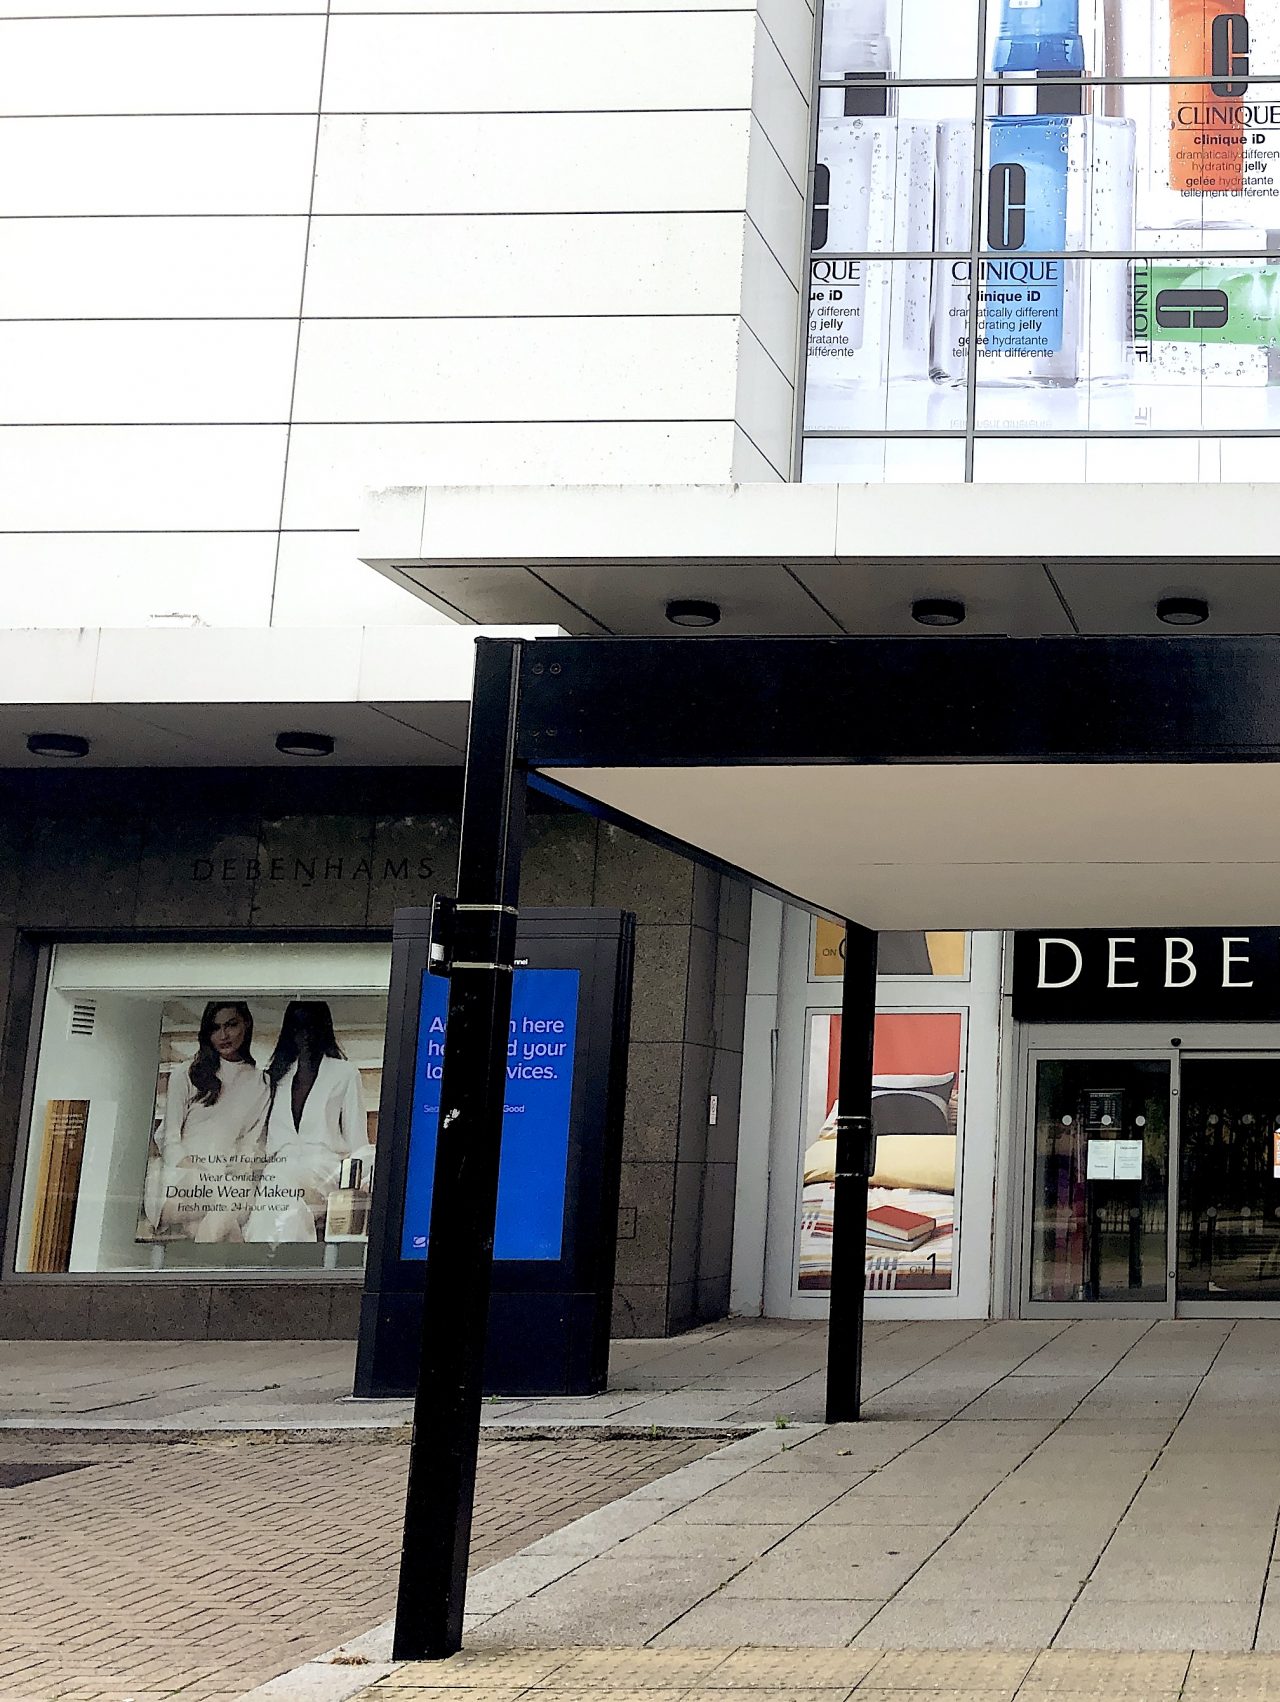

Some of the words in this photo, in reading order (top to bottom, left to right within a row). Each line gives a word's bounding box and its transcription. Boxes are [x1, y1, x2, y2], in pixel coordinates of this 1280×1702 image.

[1193, 134, 1247, 146] clinique
[1252, 134, 1266, 144] iD
[1176, 150, 1239, 161] dramatically
[1191, 161, 1242, 173] hydrating
[1244, 161, 1267, 173] jelly
[1185, 176, 1216, 187] gelée
[1218, 176, 1274, 187] hydratante
[1180, 188, 1228, 198] tellement
[1231, 187, 1280, 197] différente
[829, 290, 843, 301] iD
[1027, 290, 1041, 302] iD
[817, 306, 860, 317] different
[949, 307, 1013, 319] draatically
[1015, 307, 1059, 317] different
[819, 319, 844, 331] jelly
[965, 320, 1016, 332] hdrating
[1018, 319, 1042, 332] jelly
[958, 335, 989, 347] geée
[992, 335, 1049, 347] hydratante
[1004, 347, 1054, 358] différente
[192, 857, 436, 881] DEBENHAMS
[522, 1016, 565, 1033] here
[523, 1043, 567, 1060] your
[503, 1104, 525, 1113] Good
[190, 1154, 206, 1164] The
[240, 1154, 287, 1164] Foundation
[199, 1173, 222, 1182] Wear
[224, 1172, 276, 1182] Confidence
[165, 1185, 213, 1198] Double
[217, 1185, 250, 1198] Wear
[253, 1184, 305, 1200] Makeup
[177, 1203, 200, 1212] Fresh
[926, 1252, 936, 1279] 1
